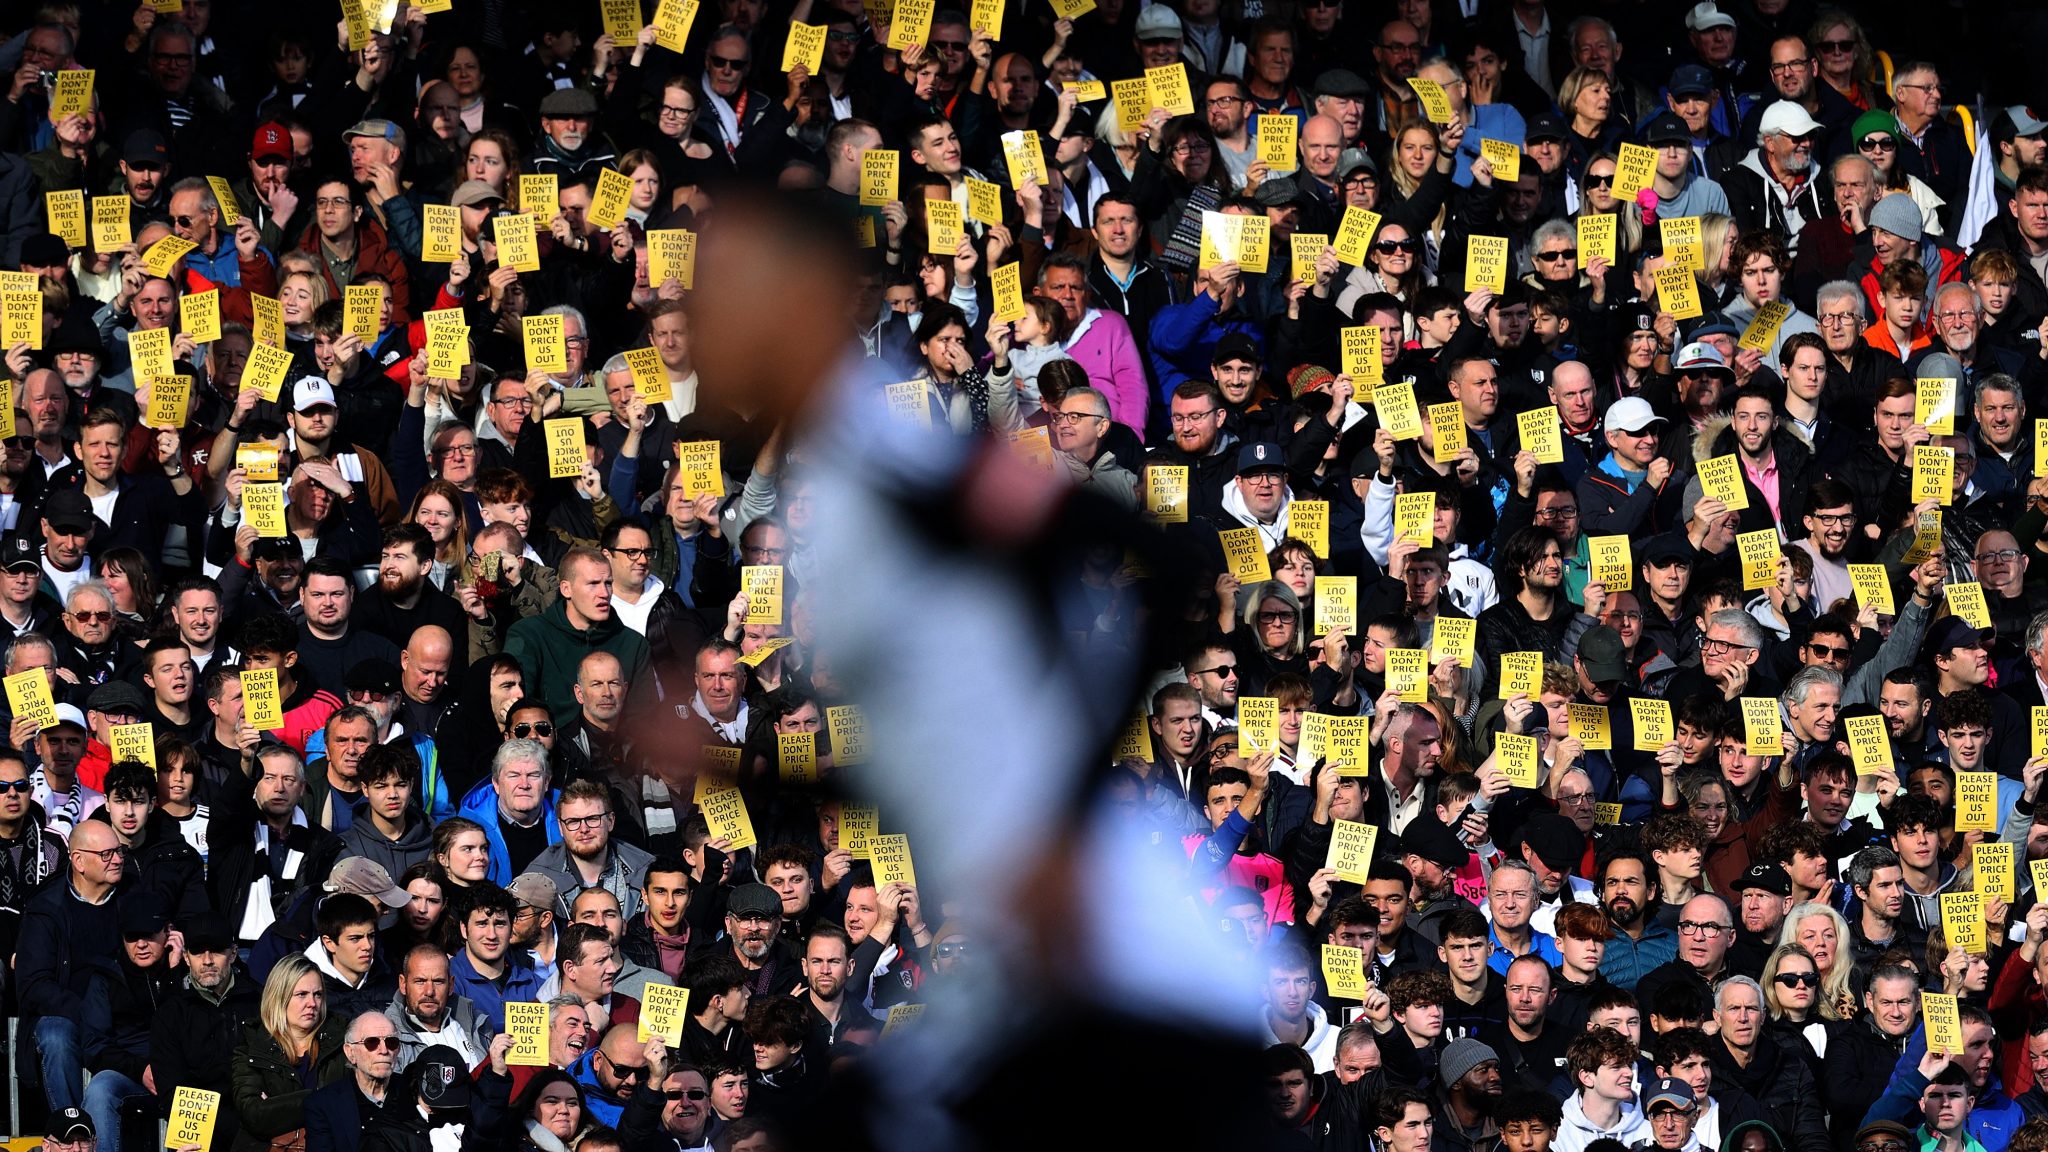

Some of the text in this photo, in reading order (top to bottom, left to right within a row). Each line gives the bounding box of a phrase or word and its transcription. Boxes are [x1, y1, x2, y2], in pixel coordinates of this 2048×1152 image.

[61, 72, 90, 80] PLEASE
[61, 80, 88, 88] DON'T
[61, 88, 86, 96] PRICE
[66, 96, 78, 104] US
[61, 104, 80, 112] OUT
[1262, 117, 1292, 125] PLEASE
[1263, 126, 1291, 134] DON'T
[1264, 135, 1289, 143] PRICE
[865, 152, 894, 160] PLEASE
[1267, 153, 1286, 161] OUT
[1624, 146, 1655, 159] PLEASE
[866, 161, 893, 169] DON'T
[1623, 155, 1652, 167] DON'T
[867, 170, 891, 179] PRICE
[1623, 164, 1648, 176] PRICE
[874, 179, 885, 187] US
[1628, 174, 1640, 183] US
[869, 188, 888, 196] OUT
[1622, 182, 1641, 193] OUT
[96, 198, 126, 207] PLEASE
[98, 207, 124, 216] DON'T
[427, 207, 457, 216] PLEASE
[98, 216, 123, 224] PRICE
[429, 216, 455, 225] DON'T
[431, 226, 454, 235] PRICE
[103, 234, 121, 242] OUT
[436, 235, 449, 243] US
[1472, 238, 1503, 247] PLEASE
[433, 244, 452, 252] OUT
[1473, 247, 1501, 256] DON'T
[1474, 256, 1498, 265] PRICE
[1475, 275, 1495, 283] OUT
[349, 288, 379, 296] PLEASE
[350, 297, 377, 305] DON'T
[351, 306, 375, 314] PRICE
[357, 315, 368, 324] US
[526, 317, 559, 326] PLEASE
[353, 325, 371, 333] OUT
[529, 326, 558, 336] DON'T
[1345, 328, 1376, 338] PLEASE
[531, 336, 557, 345] PRICE
[1347, 338, 1375, 347] DON'T
[539, 346, 551, 354] US
[627, 349, 656, 360] PLEASE
[1348, 347, 1374, 355] PRICE
[535, 355, 555, 364] OUT
[632, 358, 658, 368] DON'T
[1356, 357, 1368, 365] US
[637, 366, 660, 376] PRICE
[1353, 366, 1372, 374] OUT
[154, 376, 188, 385] PLEASE
[646, 376, 657, 384] US
[155, 385, 185, 393] DON'T
[645, 384, 662, 394] OUT
[156, 394, 182, 402] PRICE
[162, 403, 174, 411] US
[1431, 404, 1459, 415] PLEASE
[157, 411, 177, 420] OUT
[1434, 413, 1459, 424] DON'T
[1437, 423, 1460, 433] PRICE
[1445, 433, 1456, 441] US
[683, 443, 716, 453] PLEASE
[1443, 441, 1460, 451] OUT
[686, 453, 714, 462] DON'T
[688, 462, 713, 471] PRICE
[1919, 458, 1948, 467] DON'T
[554, 465, 583, 475] LEASE
[1920, 467, 1946, 476] PRICE
[695, 472, 707, 480] US
[692, 481, 712, 489] OUT
[1927, 477, 1939, 485] US
[1922, 486, 1942, 494] OUT
[1223, 529, 1256, 540] PLEASE
[1740, 532, 1772, 544] PLEASE
[1227, 537, 1256, 549] DON'T
[1744, 541, 1772, 553] DON'T
[1231, 545, 1258, 557] PRICE
[1748, 550, 1774, 561] PRICE
[1240, 555, 1254, 564] US
[1239, 563, 1258, 574] OUT
[1756, 560, 1768, 570] US
[1753, 569, 1772, 579] OUT
[243, 671, 274, 682] PLEASE
[247, 681, 273, 691] DON'T
[249, 691, 273, 701] PRICE
[256, 701, 268, 710] US
[1633, 700, 1666, 708] PLEASE
[254, 710, 272, 720] OUT
[1636, 707, 1665, 716] DON'T
[1639, 715, 1666, 724] PRICE
[1848, 718, 1880, 728] PLEASE
[1648, 724, 1660, 732] US
[1853, 727, 1880, 737] DON'T
[1644, 732, 1664, 741] OUT
[1856, 736, 1882, 746] PRICE
[1865, 745, 1878, 754] US
[1864, 754, 1882, 763] OUT
[1959, 775, 1992, 783] PLEASE
[1961, 784, 1992, 793] DON'T
[704, 791, 738, 807] PLEASE
[1963, 794, 1990, 802] PRICE
[708, 799, 738, 816] DON'T
[1970, 803, 1983, 812] US
[713, 809, 741, 824] PRICE
[1966, 813, 1987, 821] OUT
[723, 821, 737, 831] US
[1338, 822, 1372, 835] PLEASE
[723, 829, 742, 842] OUT
[1338, 832, 1368, 844] DON'T
[1338, 841, 1365, 853] PRICE
[1976, 845, 2009, 855] PLEASE
[1343, 852, 1356, 861] US
[1978, 855, 2008, 865] DON'T
[1337, 861, 1358, 871] OUT
[1980, 865, 2007, 874] PRICE
[1988, 875, 2000, 884] US
[1984, 884, 2004, 893] OUT
[648, 985, 684, 998] PLEASE
[649, 995, 681, 1007] DON'T
[1924, 995, 1953, 1005] PLEASE
[510, 1005, 545, 1014] PLEASE
[649, 1005, 677, 1016] PRICE
[1927, 1005, 1952, 1014] DON'T
[511, 1015, 543, 1024] DON'T
[655, 1015, 668, 1024] US
[1930, 1015, 1953, 1024] PRICE
[513, 1025, 541, 1034] PRICE
[650, 1024, 671, 1033] OUT
[1937, 1025, 1948, 1034] US
[521, 1036, 534, 1044] US
[1934, 1034, 1952, 1043] OUT
[516, 1045, 538, 1054] OUT
[179, 1089, 215, 1102] PLEASE
[179, 1099, 211, 1112] DON'T
[178, 1109, 208, 1122] PRICE
[184, 1120, 198, 1131] US
[178, 1130, 201, 1141] OUT
